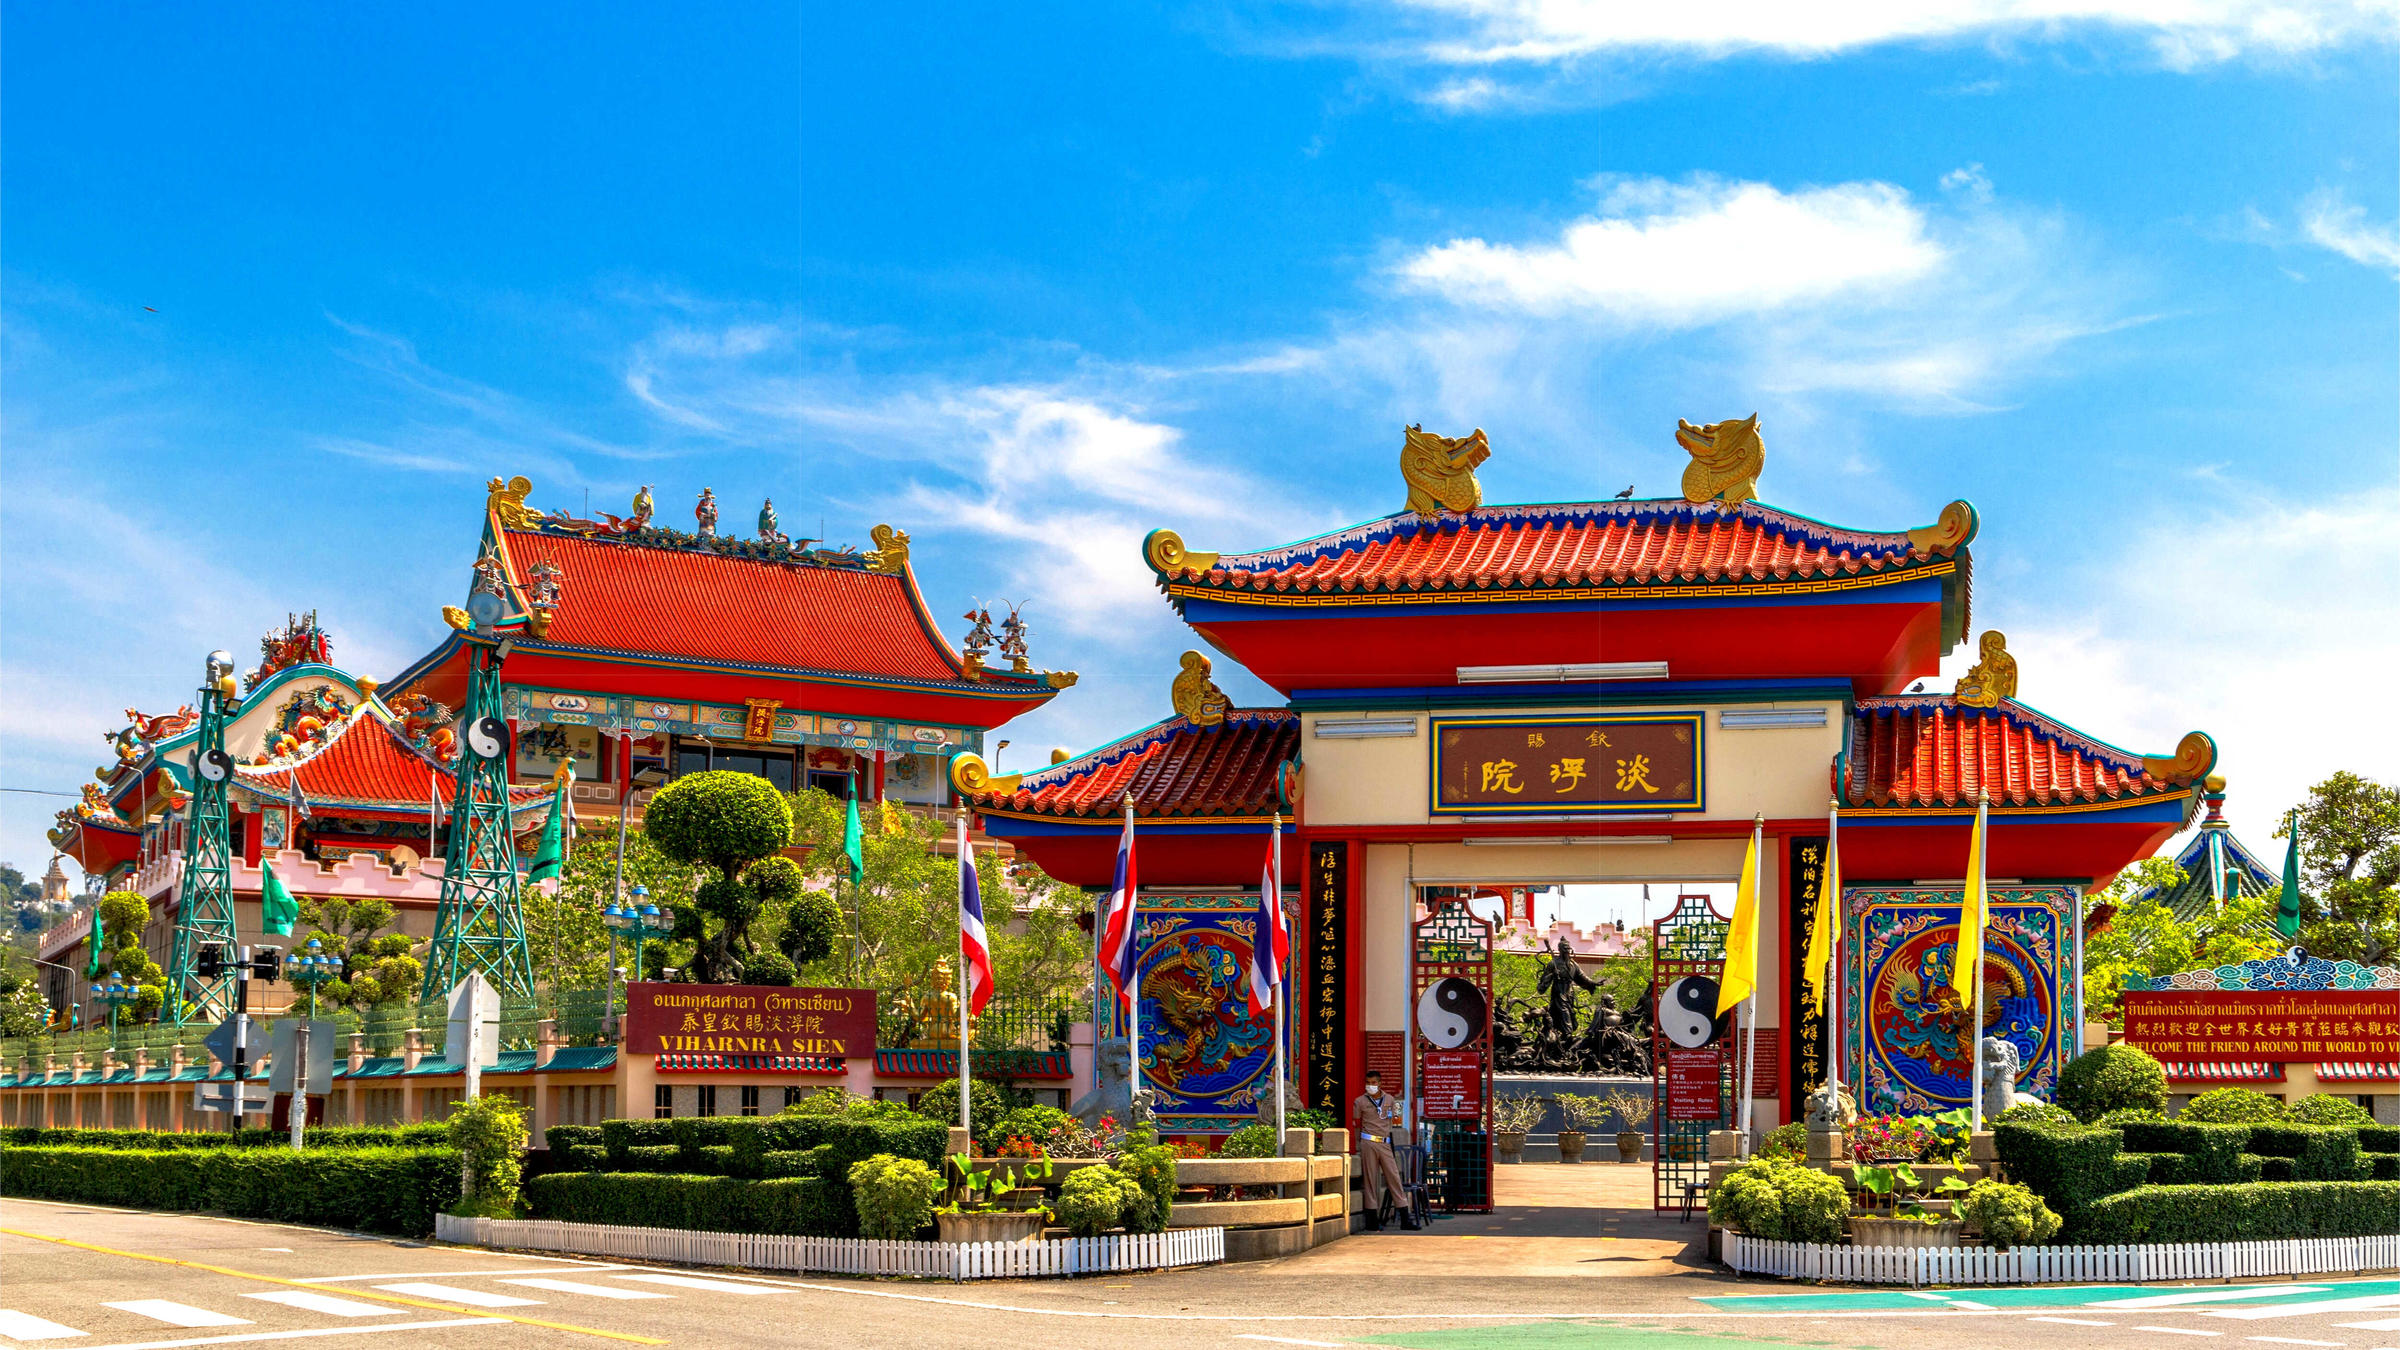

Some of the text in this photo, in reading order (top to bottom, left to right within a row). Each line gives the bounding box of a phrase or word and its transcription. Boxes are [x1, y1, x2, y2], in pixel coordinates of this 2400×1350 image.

[653, 993, 852, 1015] อเนกกุศลศาลา (วิหารเซียน)
[658, 1035, 846, 1054] VIHARNRA SIEN
[2186, 1041, 2207, 1053] THE
[2210, 1041, 2250, 1053] FRIEND
[2253, 1041, 2298, 1053] AROUND
[2301, 1041, 2322, 1053] THE
[2326, 1041, 2367, 1053] WORLD
[2369, 1041, 2385, 1053] TO
